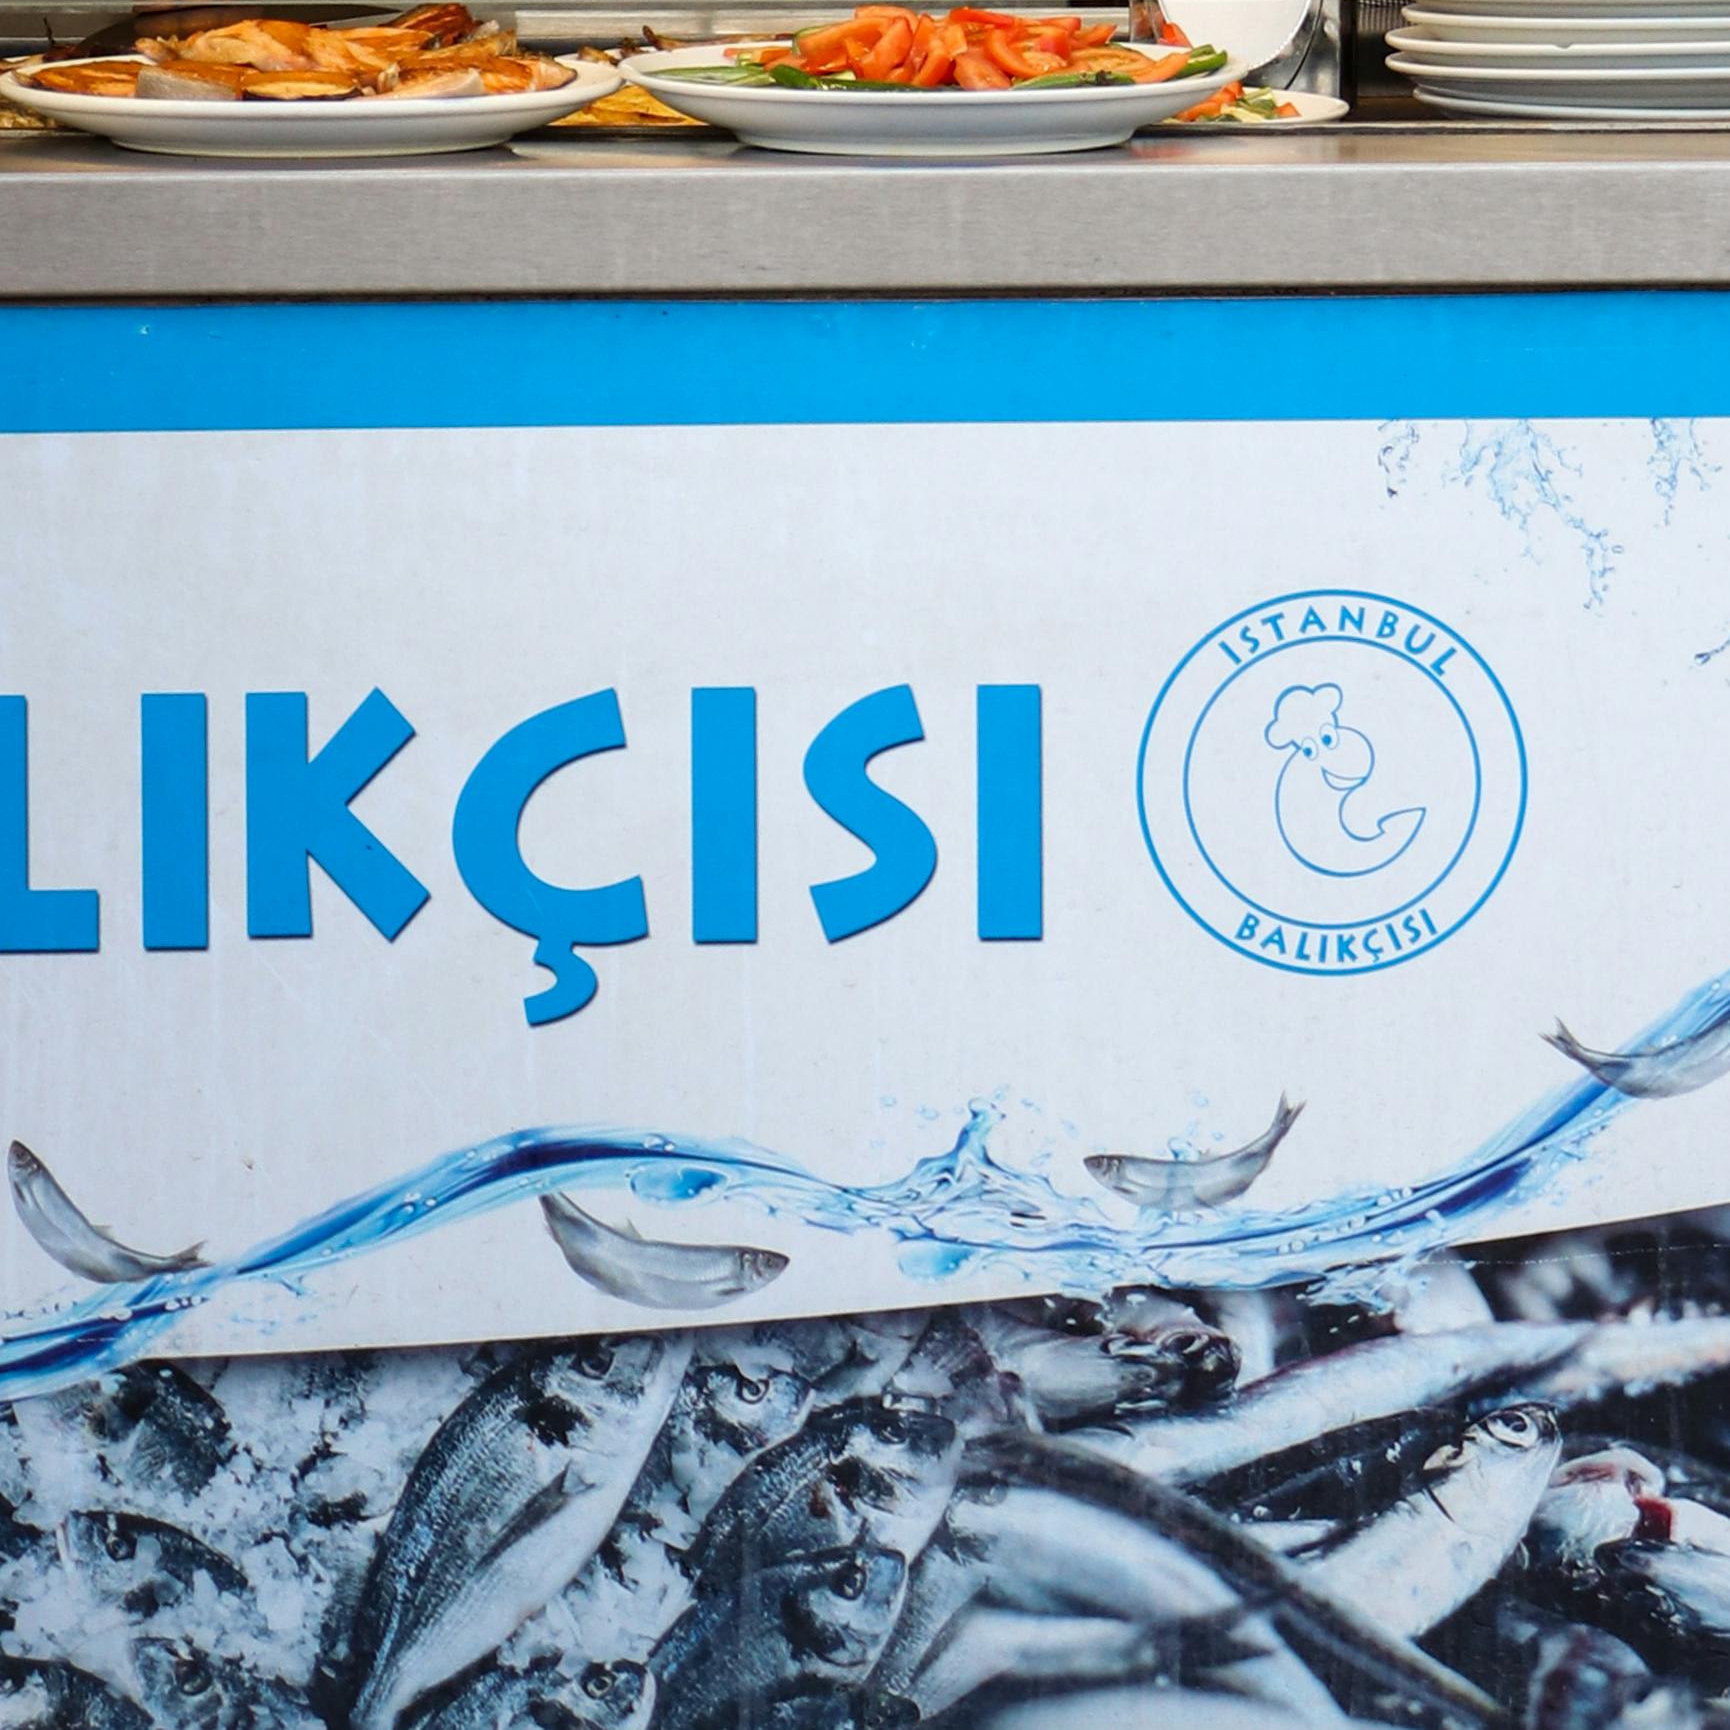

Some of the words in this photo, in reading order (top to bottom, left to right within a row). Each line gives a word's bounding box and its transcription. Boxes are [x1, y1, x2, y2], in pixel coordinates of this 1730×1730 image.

[1217, 604, 1458, 677] ISTANBUL
[0, 683, 1043, 1027] LIKÇISI
[1233, 907, 1439, 964] BALIKÇISI
